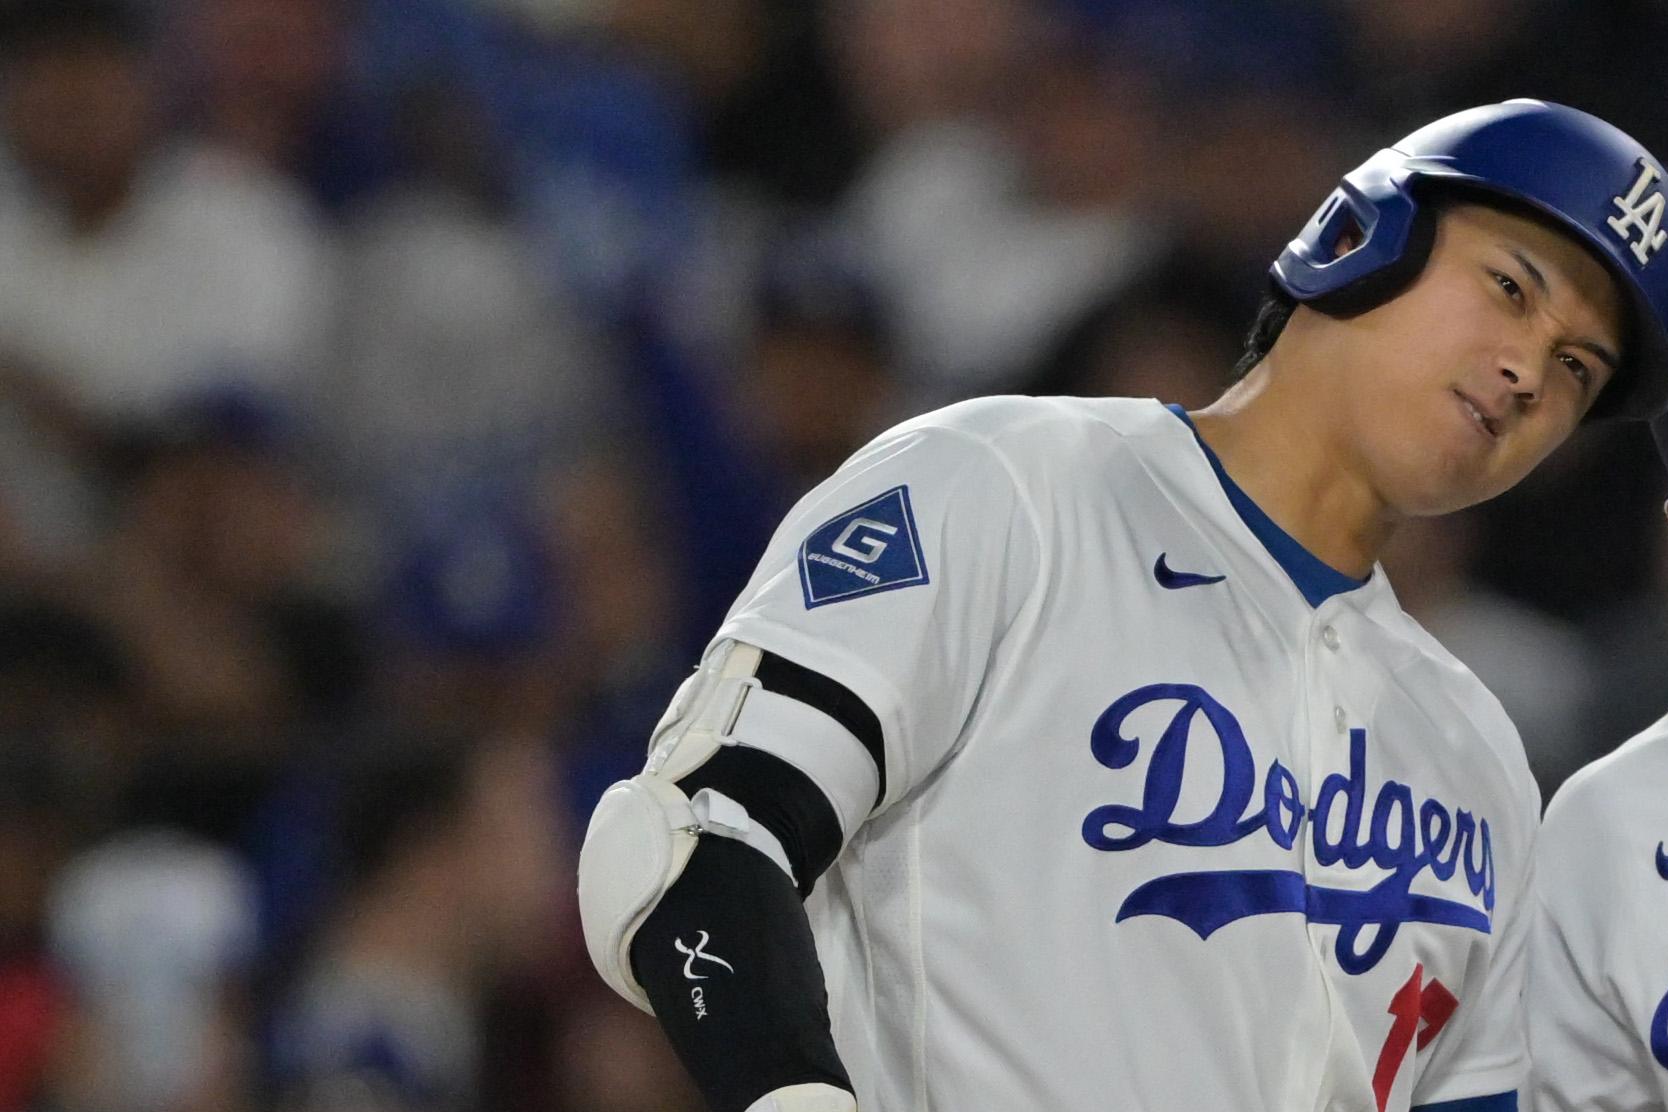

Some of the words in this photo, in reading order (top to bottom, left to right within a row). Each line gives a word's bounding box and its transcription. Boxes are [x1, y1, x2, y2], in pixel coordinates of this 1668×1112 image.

[1607, 157, 1668, 266] LA
[807, 552, 881, 585] GUGGENHEIM
[831, 517, 899, 565] G
[1081, 682, 1496, 976] Dodgers
